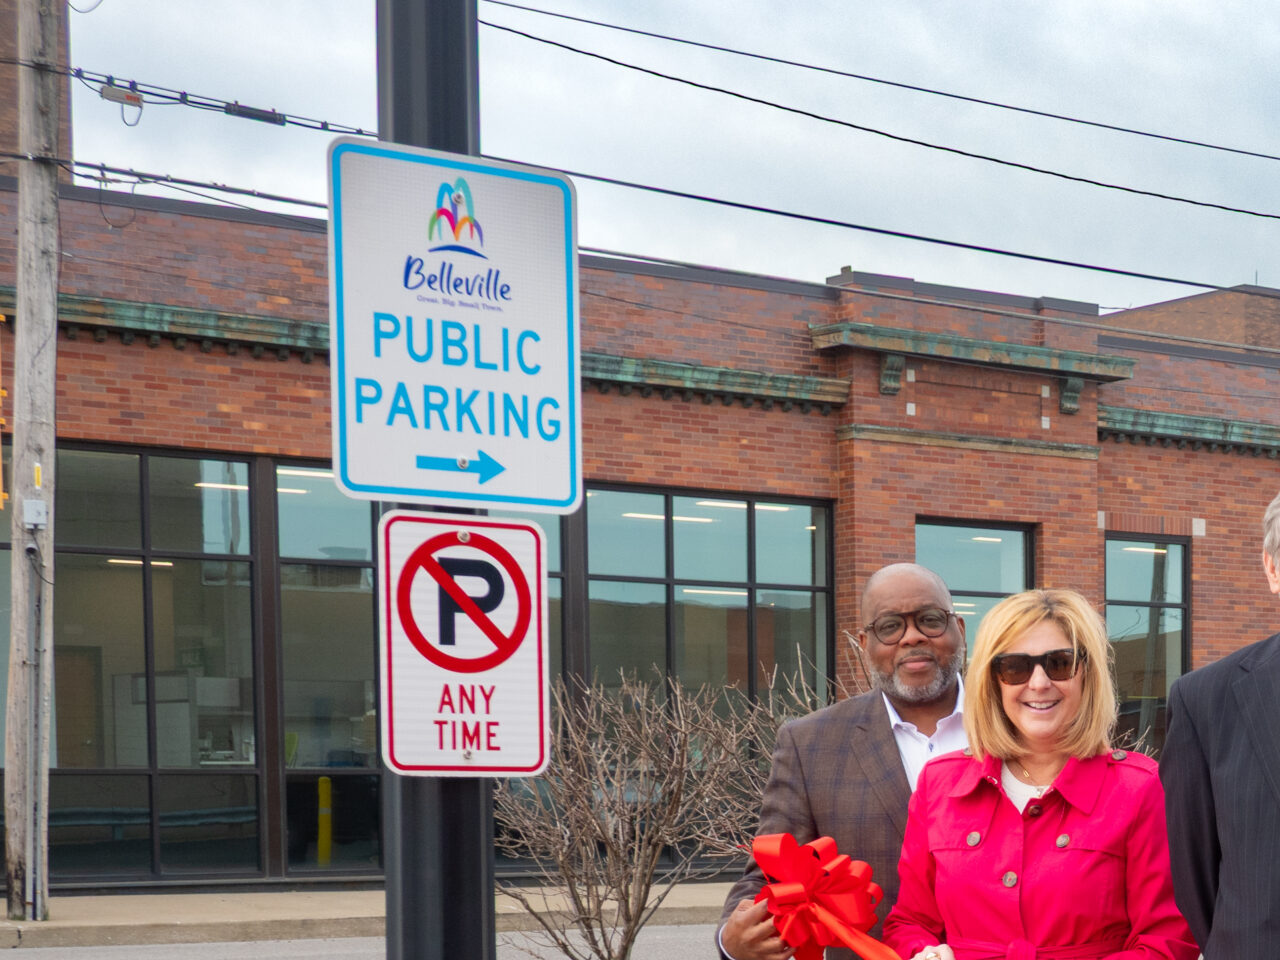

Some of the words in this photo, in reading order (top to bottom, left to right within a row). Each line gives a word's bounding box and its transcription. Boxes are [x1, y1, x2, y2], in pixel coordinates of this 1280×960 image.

[403, 255, 512, 301] Belleville
[373, 312, 541, 376] PUBLIC
[355, 377, 561, 441] PARKING
[438, 684, 496, 714] ANY
[433, 720, 501, 751] TIME
